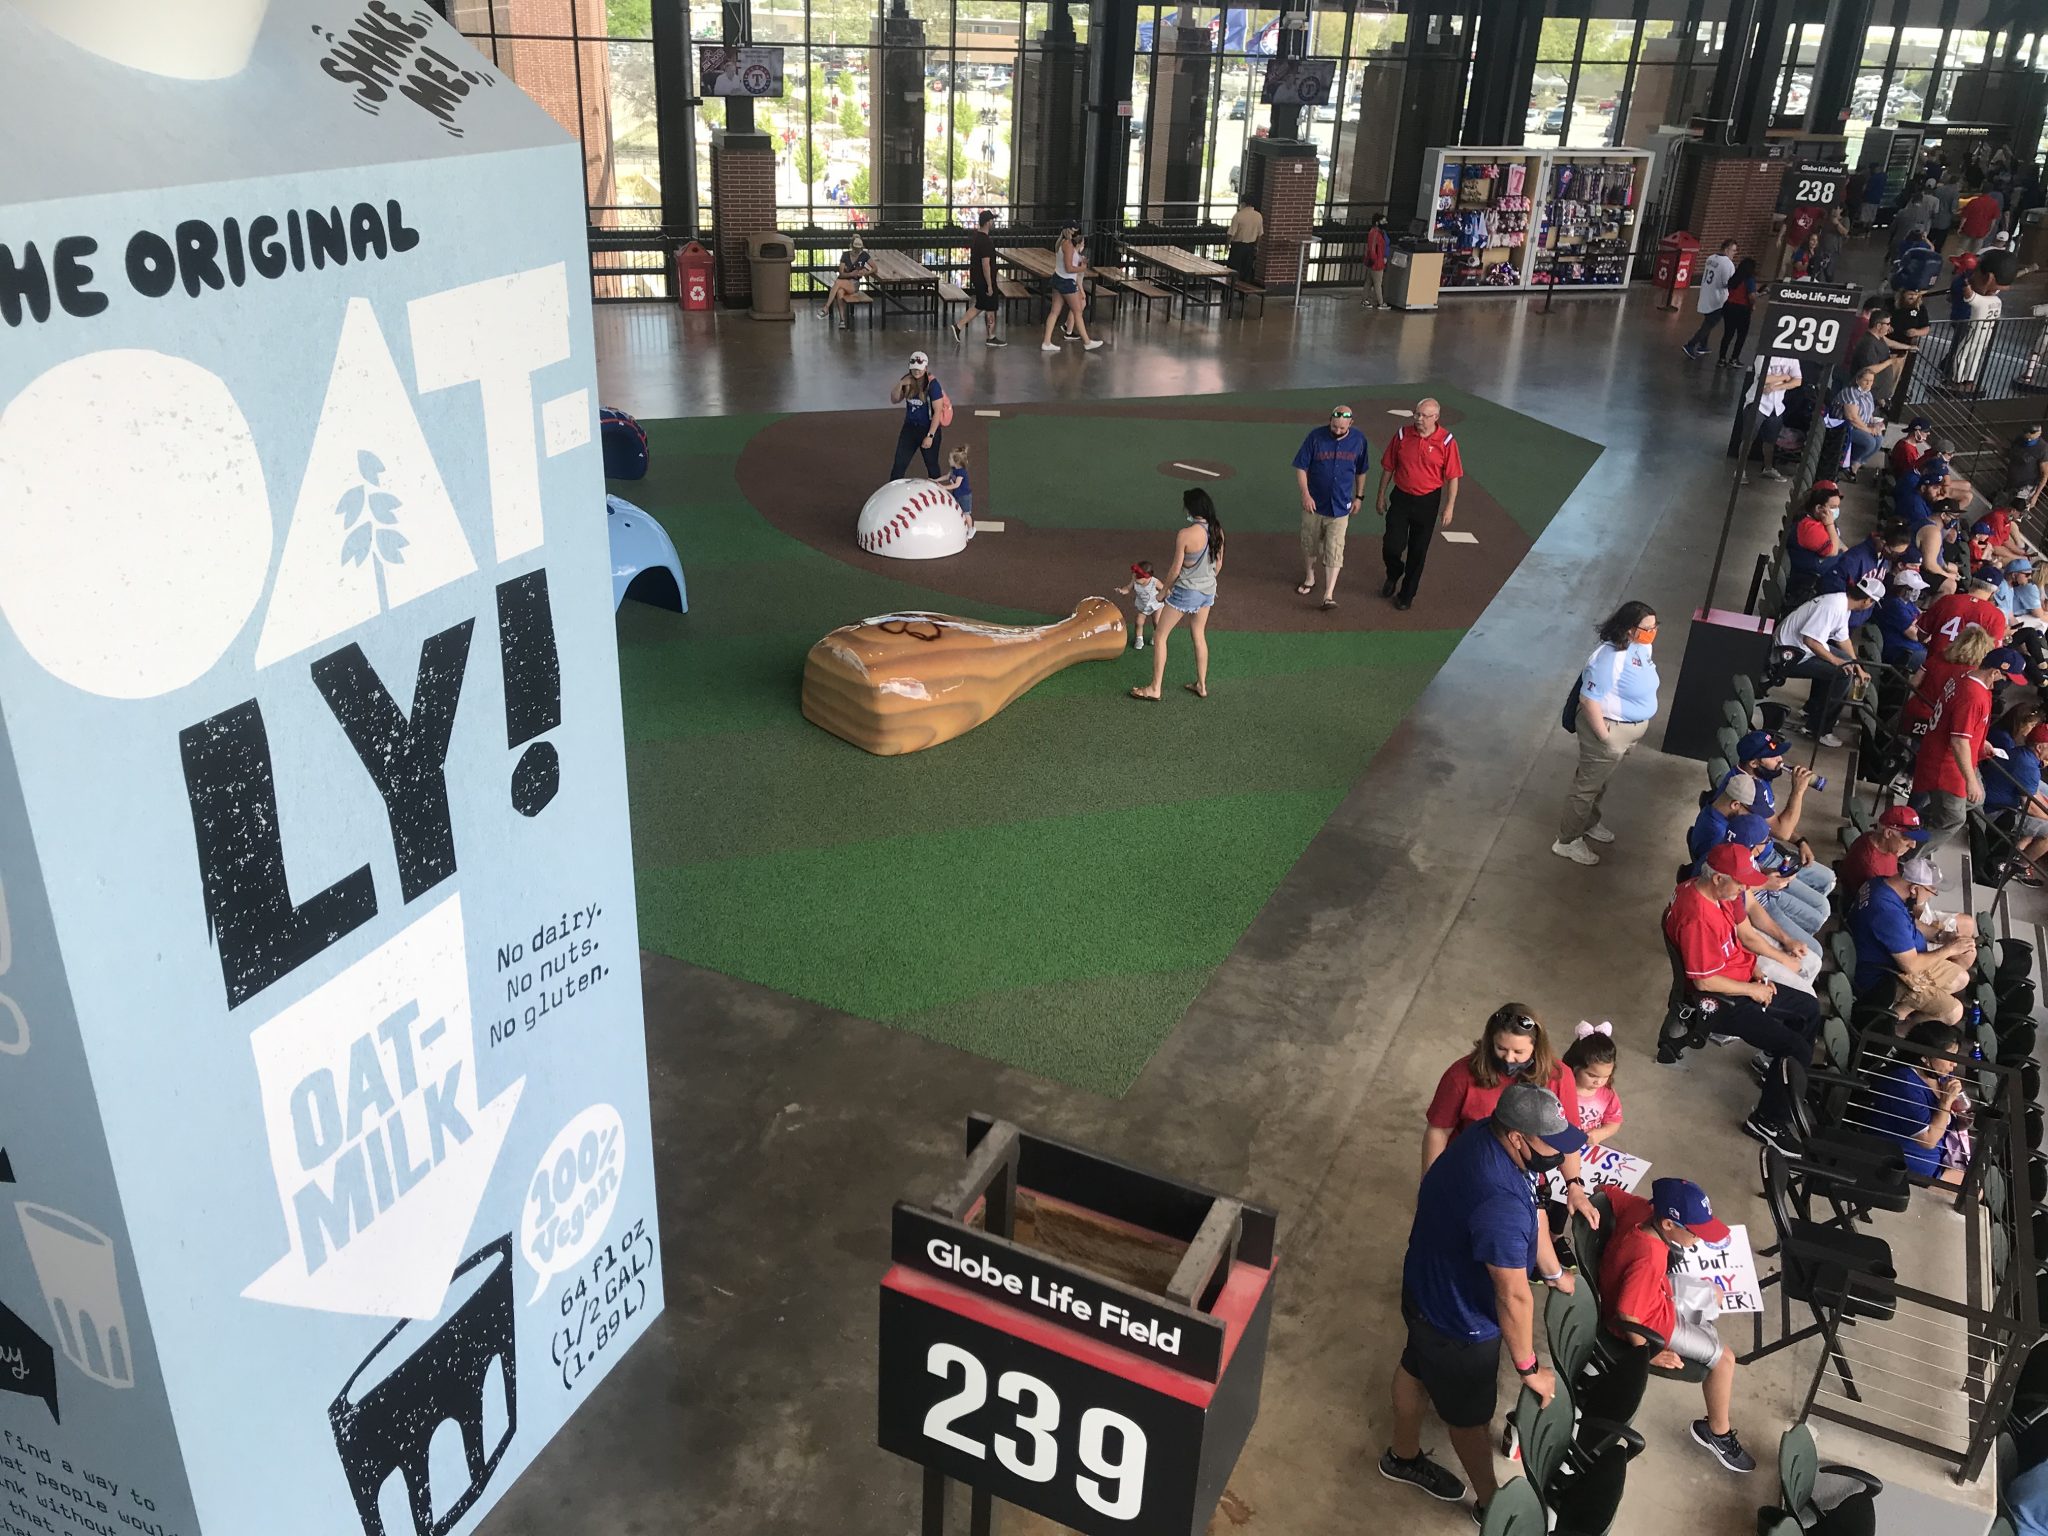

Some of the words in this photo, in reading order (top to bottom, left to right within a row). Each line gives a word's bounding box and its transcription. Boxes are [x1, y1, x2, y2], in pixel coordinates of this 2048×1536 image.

[320, 0, 428, 102] SHAKE
[399, 45, 480, 123] ME!
[1795, 180, 1836, 204] 238
[1801, 164, 1818, 172] Globe
[1818, 165, 1829, 173] Life
[125, 199, 420, 299] ORIGINAL
[1772, 315, 1840, 354] 239
[1780, 288, 1808, 301] Globe
[1809, 292, 1826, 302] Life
[1827, 294, 1851, 305] Field
[497, 943, 523, 973] No
[532, 902, 602, 953] dairy.
[507, 973, 532, 1003] No
[540, 938, 599, 982] nuts.
[489, 1017, 516, 1048] No
[524, 964, 609, 1032] gluten.
[292, 1059, 474, 1277] MILK
[531, 1124, 619, 1229] 100%
[531, 1166, 618, 1264] Vegan
[552, 1299, 602, 1367] (1/2
[605, 1236, 653, 1305] GAL)
[561, 1275, 587, 1317] 64
[621, 1217, 645, 1252] oz
[926, 1238, 1023, 1296] Globe
[1030, 1275, 1092, 1321] Life
[1099, 1301, 1182, 1356] Field
[4, 1429, 52, 1464] find
[61, 1459, 74, 1474] a
[83, 1469, 119, 1497] way
[130, 1488, 156, 1512] to
[922, 1341, 1148, 1522] 239
[8, 1500, 56, 1534] that
[36, 1470, 109, 1514] people
[118, 1509, 179, 1536] woul
[36, 1494, 117, 1536] without
